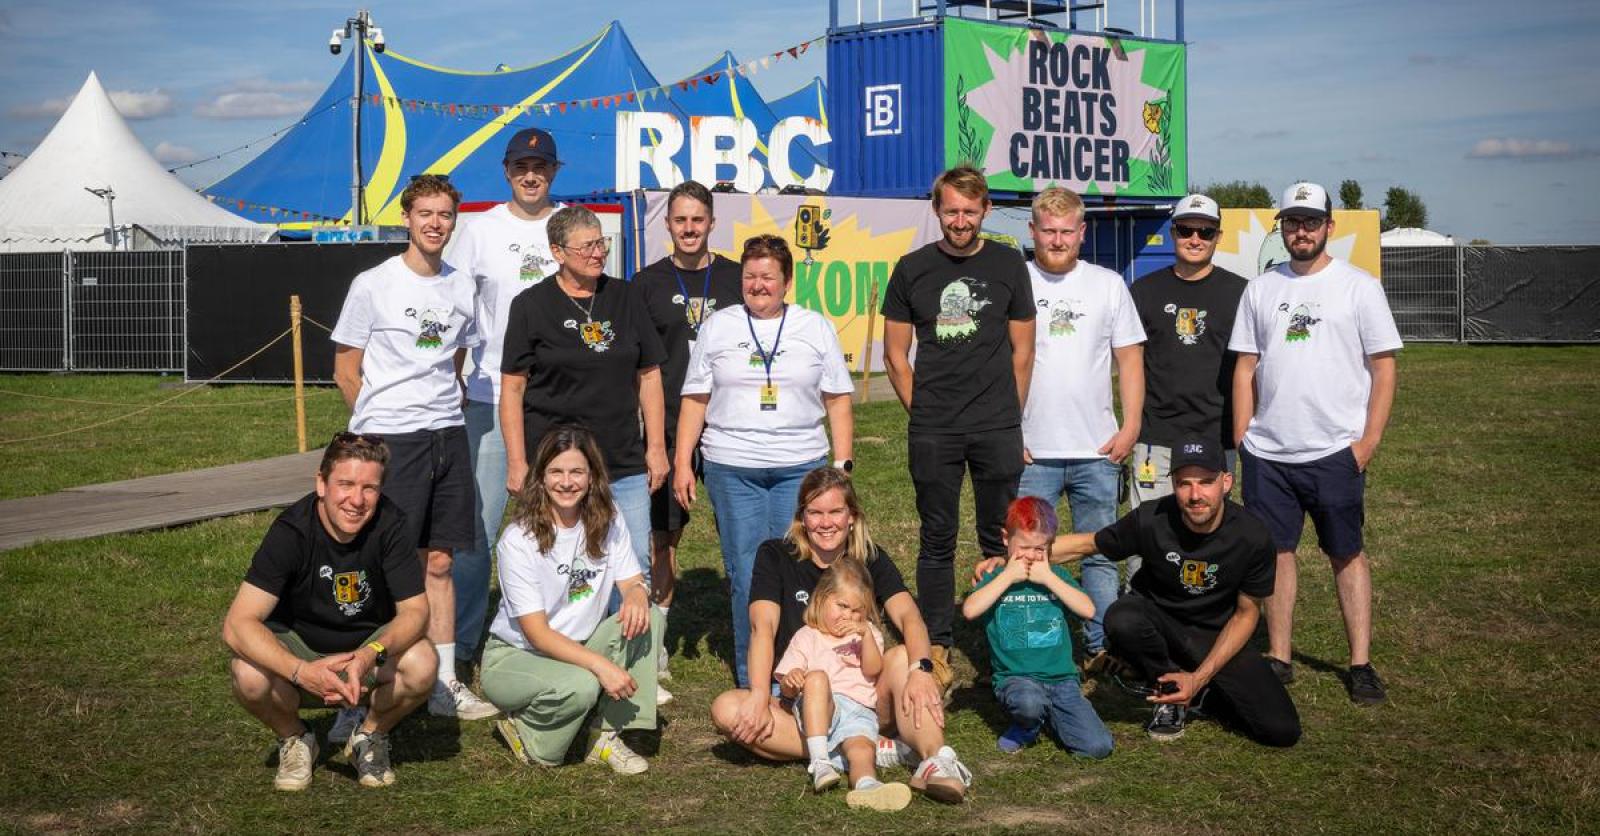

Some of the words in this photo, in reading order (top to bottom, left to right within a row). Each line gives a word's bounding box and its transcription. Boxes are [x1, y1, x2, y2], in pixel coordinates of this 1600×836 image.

[1029, 40, 1111, 90] ROCK
[1022, 87, 1117, 137] BEATS
[615, 111, 834, 194] RBC
[1009, 132, 1131, 182] CANCER
